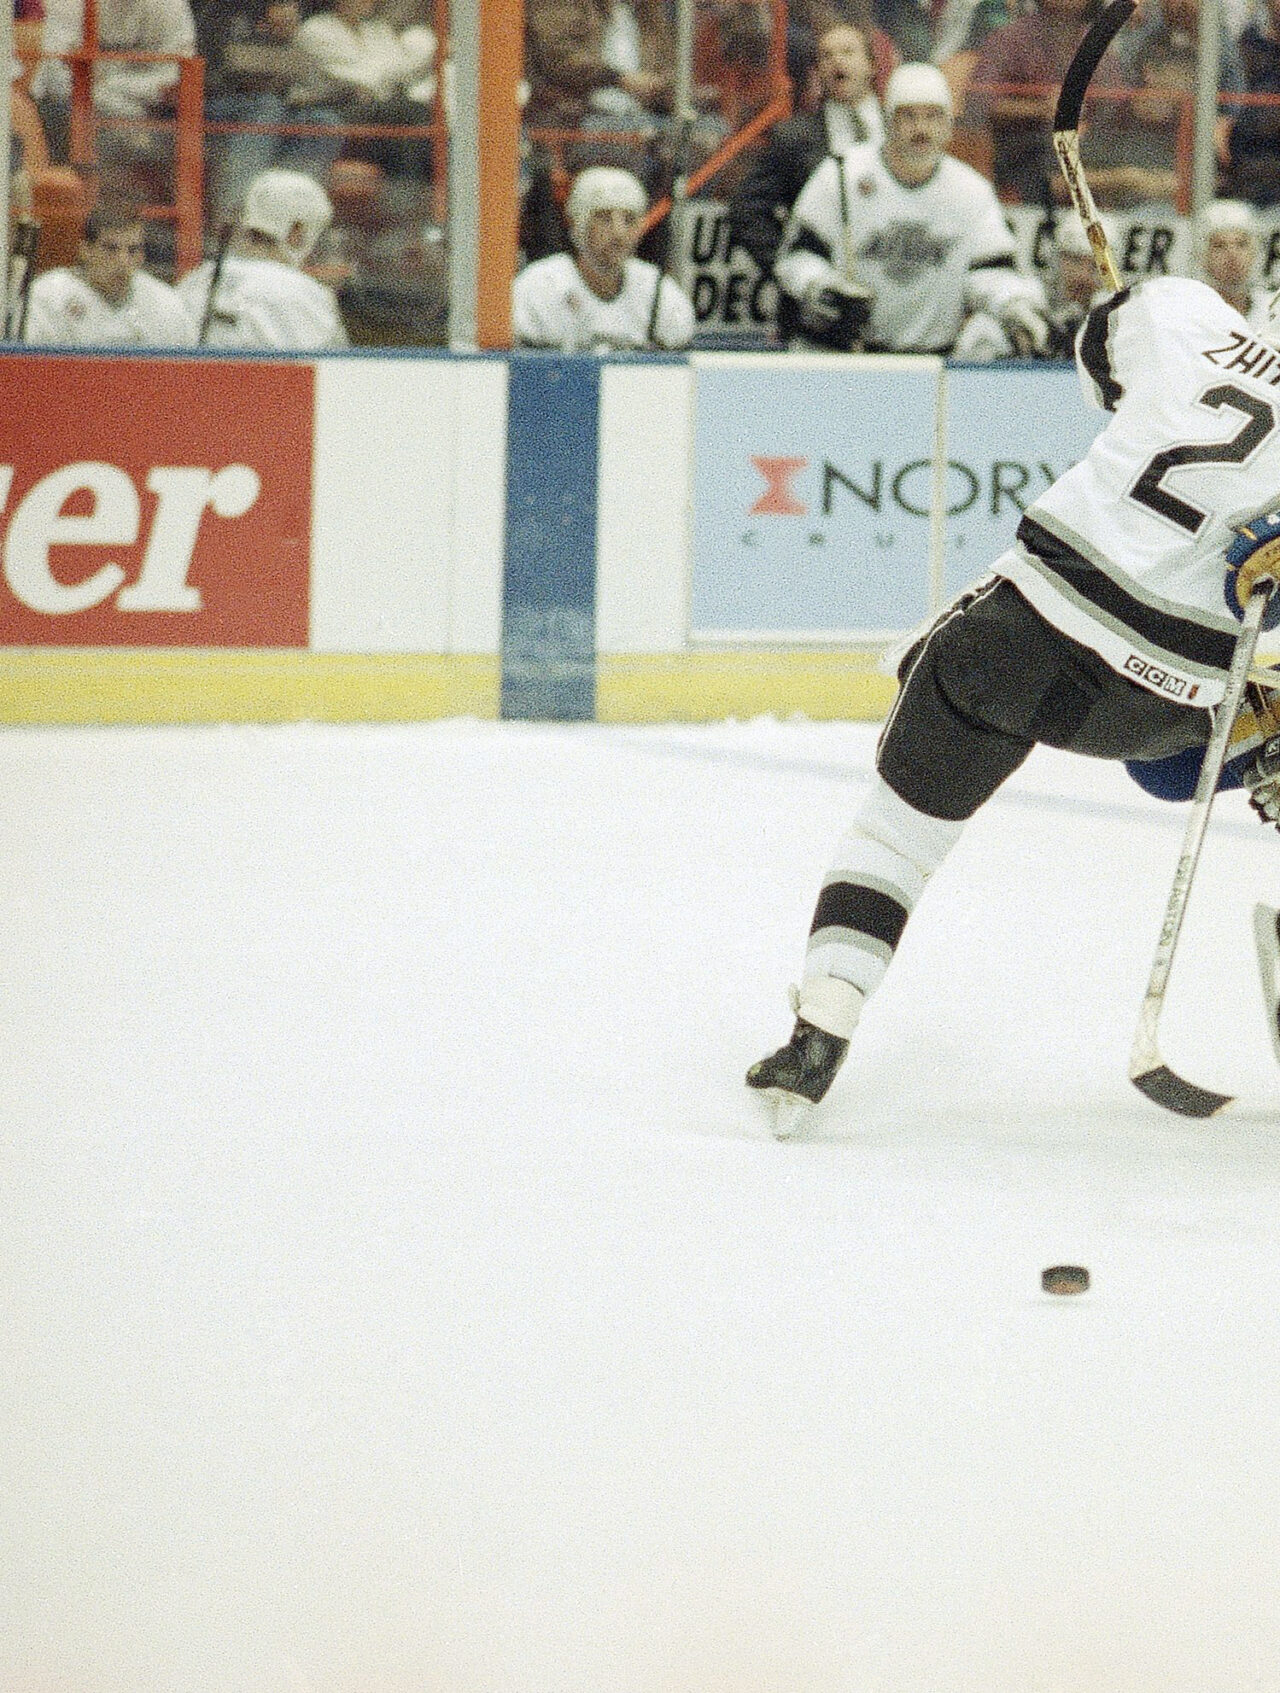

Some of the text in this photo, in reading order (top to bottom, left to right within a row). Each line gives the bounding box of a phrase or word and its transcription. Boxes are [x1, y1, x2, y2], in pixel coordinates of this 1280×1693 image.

[1130, 384, 1275, 535] 2
[0, 460, 262, 614] er
[1124, 655, 1186, 696] CCM
